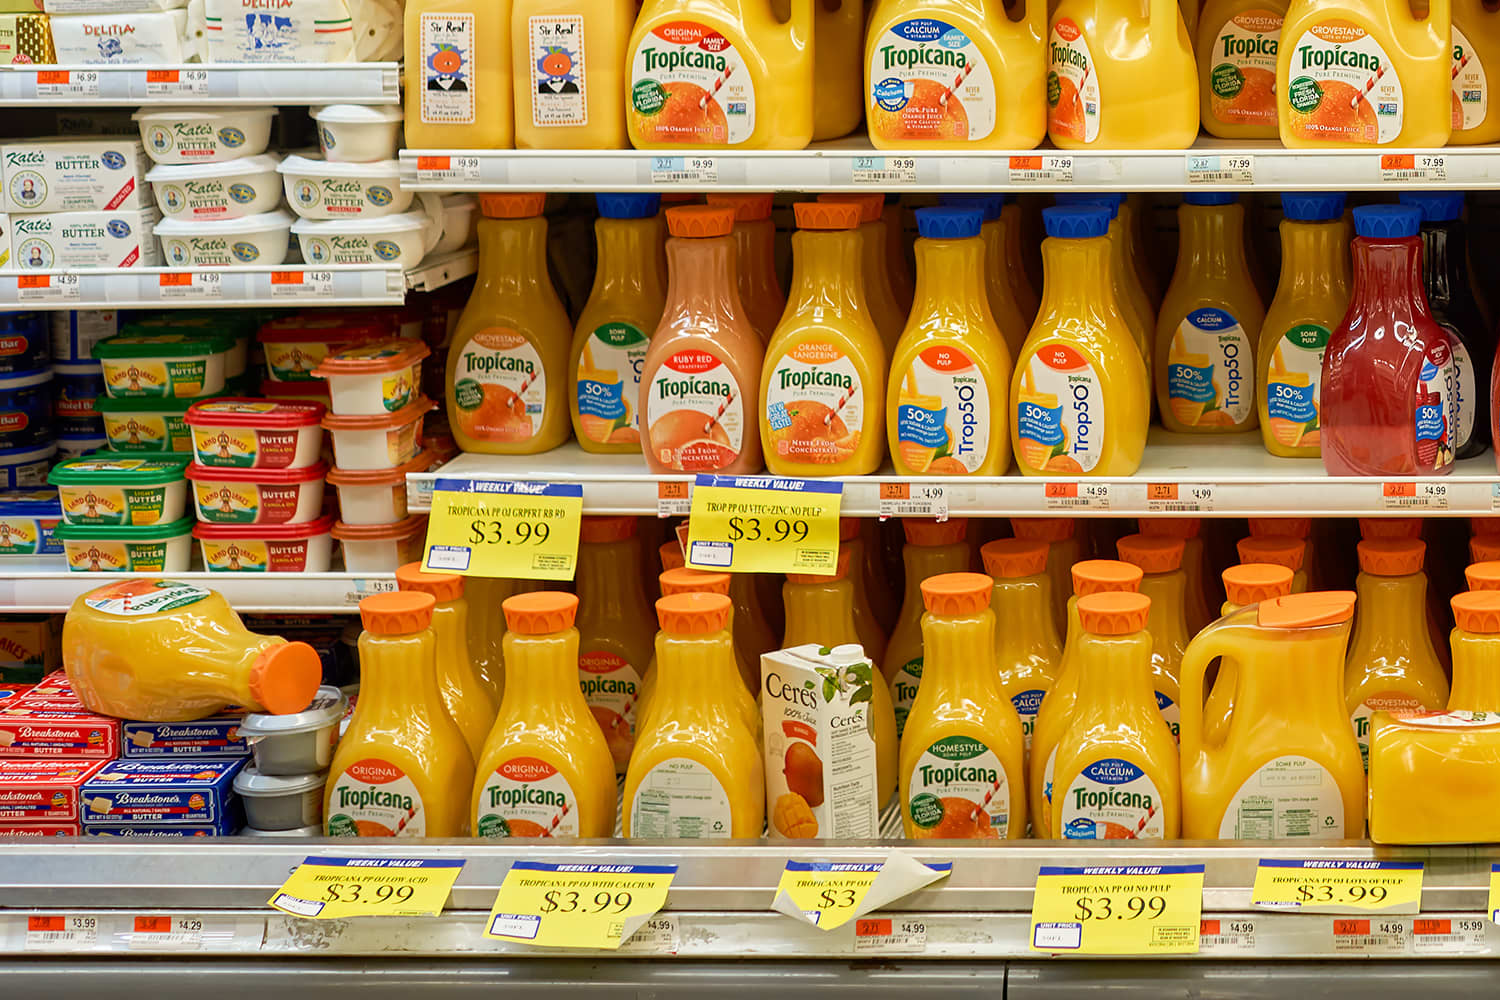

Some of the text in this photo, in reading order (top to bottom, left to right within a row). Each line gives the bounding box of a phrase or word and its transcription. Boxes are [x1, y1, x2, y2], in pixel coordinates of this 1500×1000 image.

[663, 28, 702, 38] ORIGINAL
[904, 25, 940, 36] CALCIUM
[1311, 25, 1365, 37] GROVESTAND
[642, 46, 726, 73] Tropicana
[880, 43, 966, 69] Tropicana
[1299, 44, 1381, 72] Tropicana
[174, 122, 213, 138] Kate's
[177, 142, 216, 150] BUTTER
[6, 150, 46, 167] Kate's
[55, 160, 100, 170] BUTTER
[893, 159, 914, 169] $9.99
[797, 344, 832, 352] ORANGE
[673, 354, 712, 364] RUBY RED
[793, 351, 838, 359] TANGERINE
[656, 376, 730, 399] Tropicana
[735, 478, 805, 490] WEEKLY VALUE!
[728, 516, 809, 543] $3.99
[765, 672, 817, 709] Ceres
[932, 743, 984, 753] HOMESTYLE
[351, 765, 398, 778] ORIGINAL
[920, 762, 998, 787] Tropicana
[115, 792, 182, 805] Breakstone's
[337, 785, 413, 810] Tropicana
[540, 890, 633, 914] $3.99
